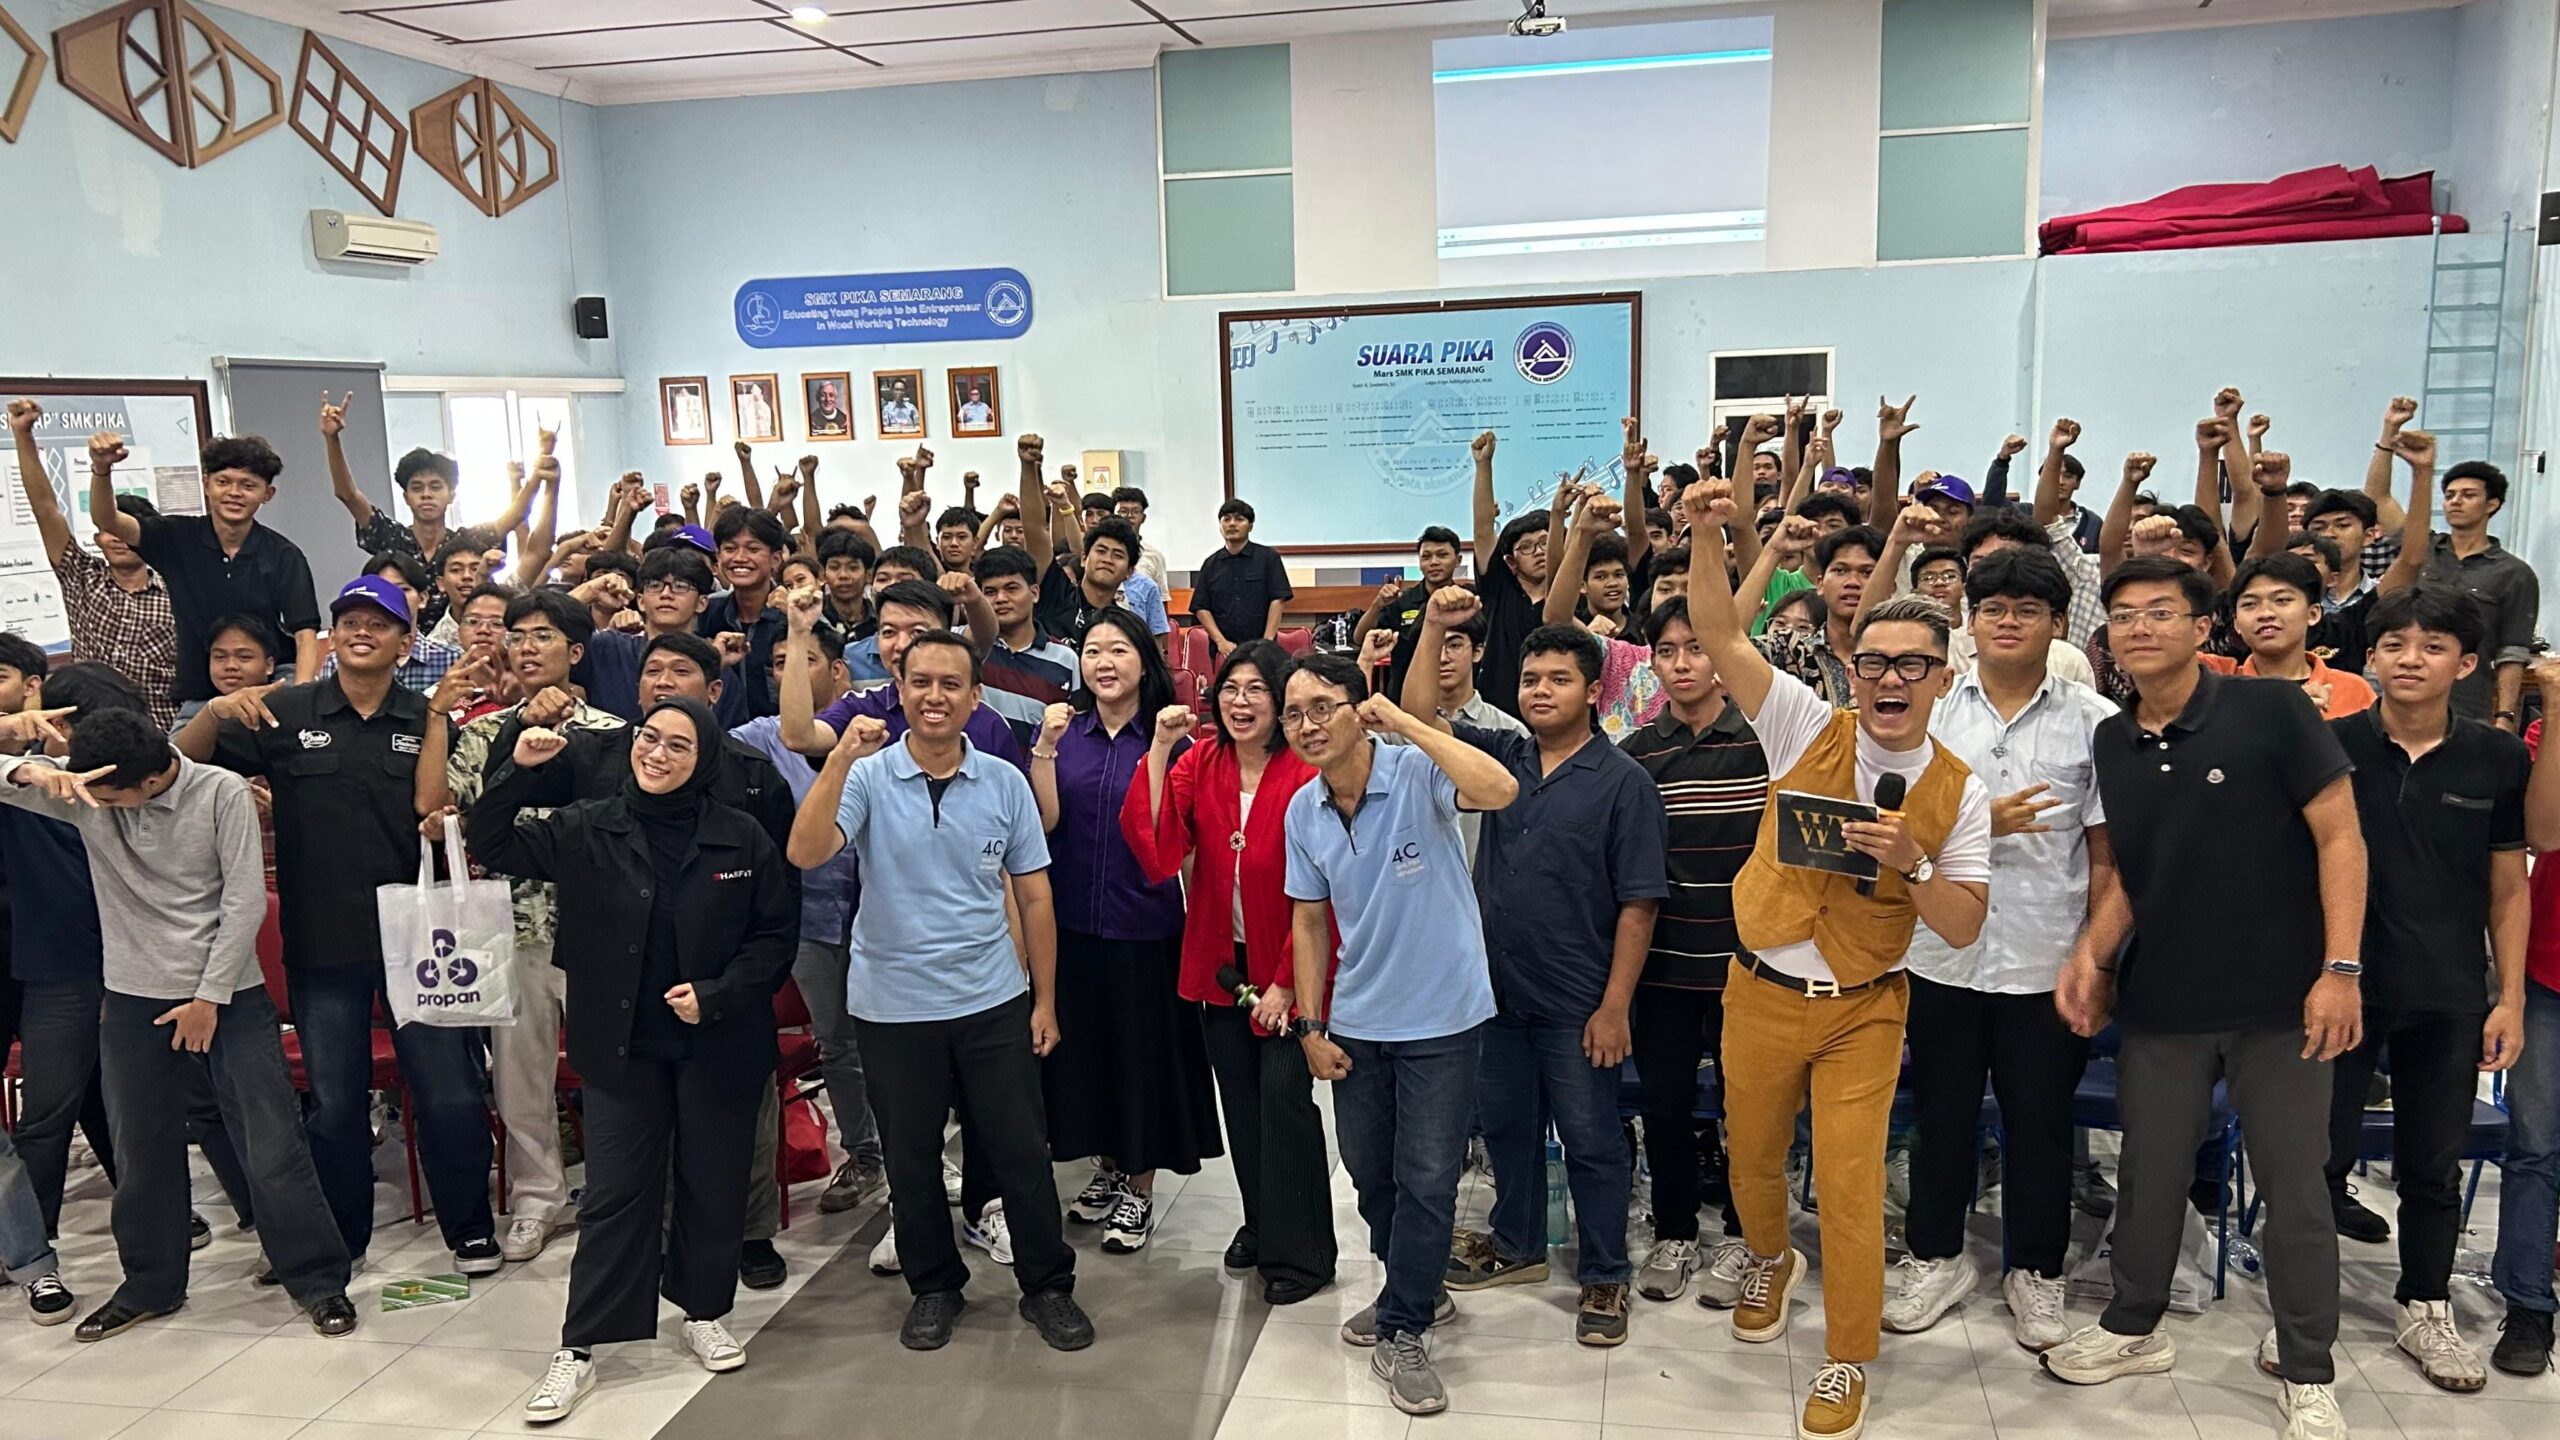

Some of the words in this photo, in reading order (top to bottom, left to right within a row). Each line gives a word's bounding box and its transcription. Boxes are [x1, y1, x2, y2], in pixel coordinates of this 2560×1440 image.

[804, 291, 838, 306] SMK
[840, 290, 877, 304] PIKA
[879, 286, 964, 303] SEMARANG
[783, 309, 829, 320] Educating
[830, 307, 860, 319] Young
[861, 305, 893, 317] People
[894, 316, 949, 329] Technology
[1357, 342, 1434, 367] SUARA
[1440, 339, 1494, 363] PIKA
[1373, 370, 1394, 378] Mars
[1395, 368, 1414, 377] SMK
[1415, 368, 1435, 376] PIKA
[1436, 365, 1485, 375] SEMARANG
[60, 412, 92, 429] SMK
[94, 411, 126, 428] PIKA
[981, 839, 1004, 856] 4C
[1391, 841, 1421, 863] 4C
[417, 990, 481, 1007] propan
